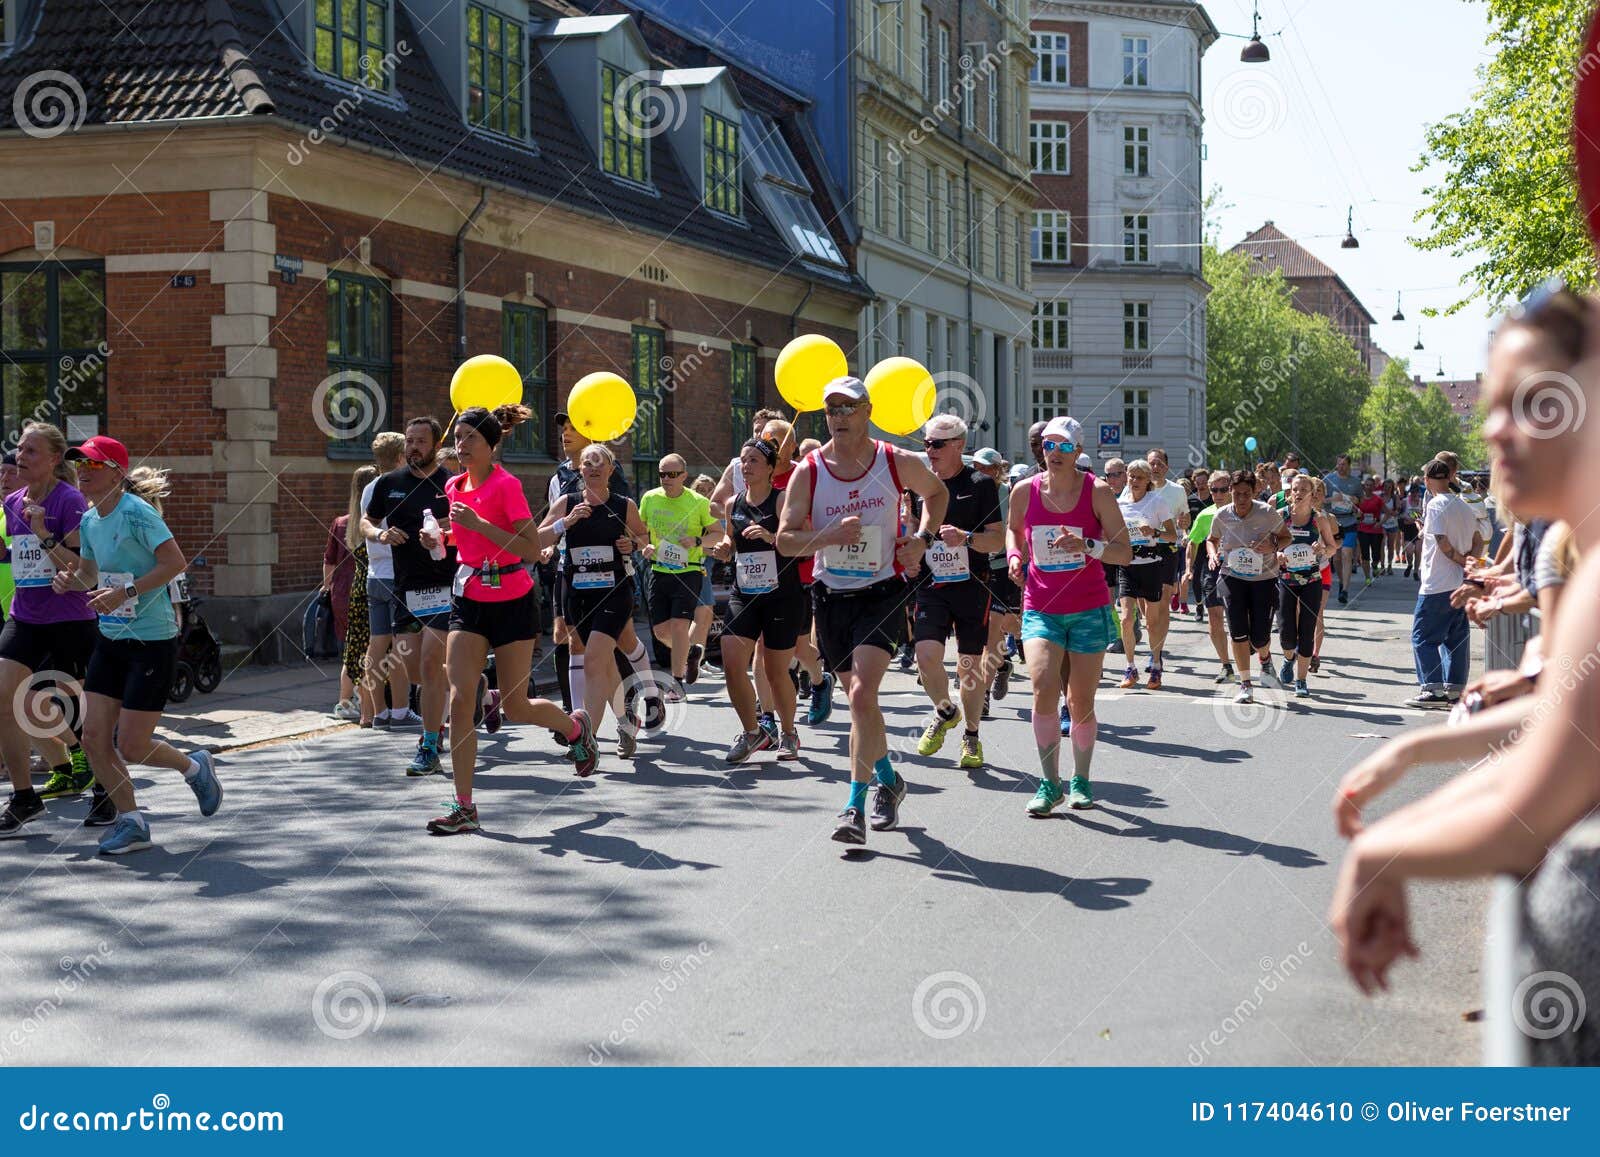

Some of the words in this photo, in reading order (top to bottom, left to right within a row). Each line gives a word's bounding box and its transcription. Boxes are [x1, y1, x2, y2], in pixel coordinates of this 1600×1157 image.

[1103, 428, 1118, 439] 30
[826, 497, 885, 516] DANMARK
[19, 549, 41, 560] 4418
[932, 552, 960, 562] 9004
[1238, 556, 1253, 564] 334
[1292, 550, 1308, 559] 5411
[743, 563, 767, 574] 7287
